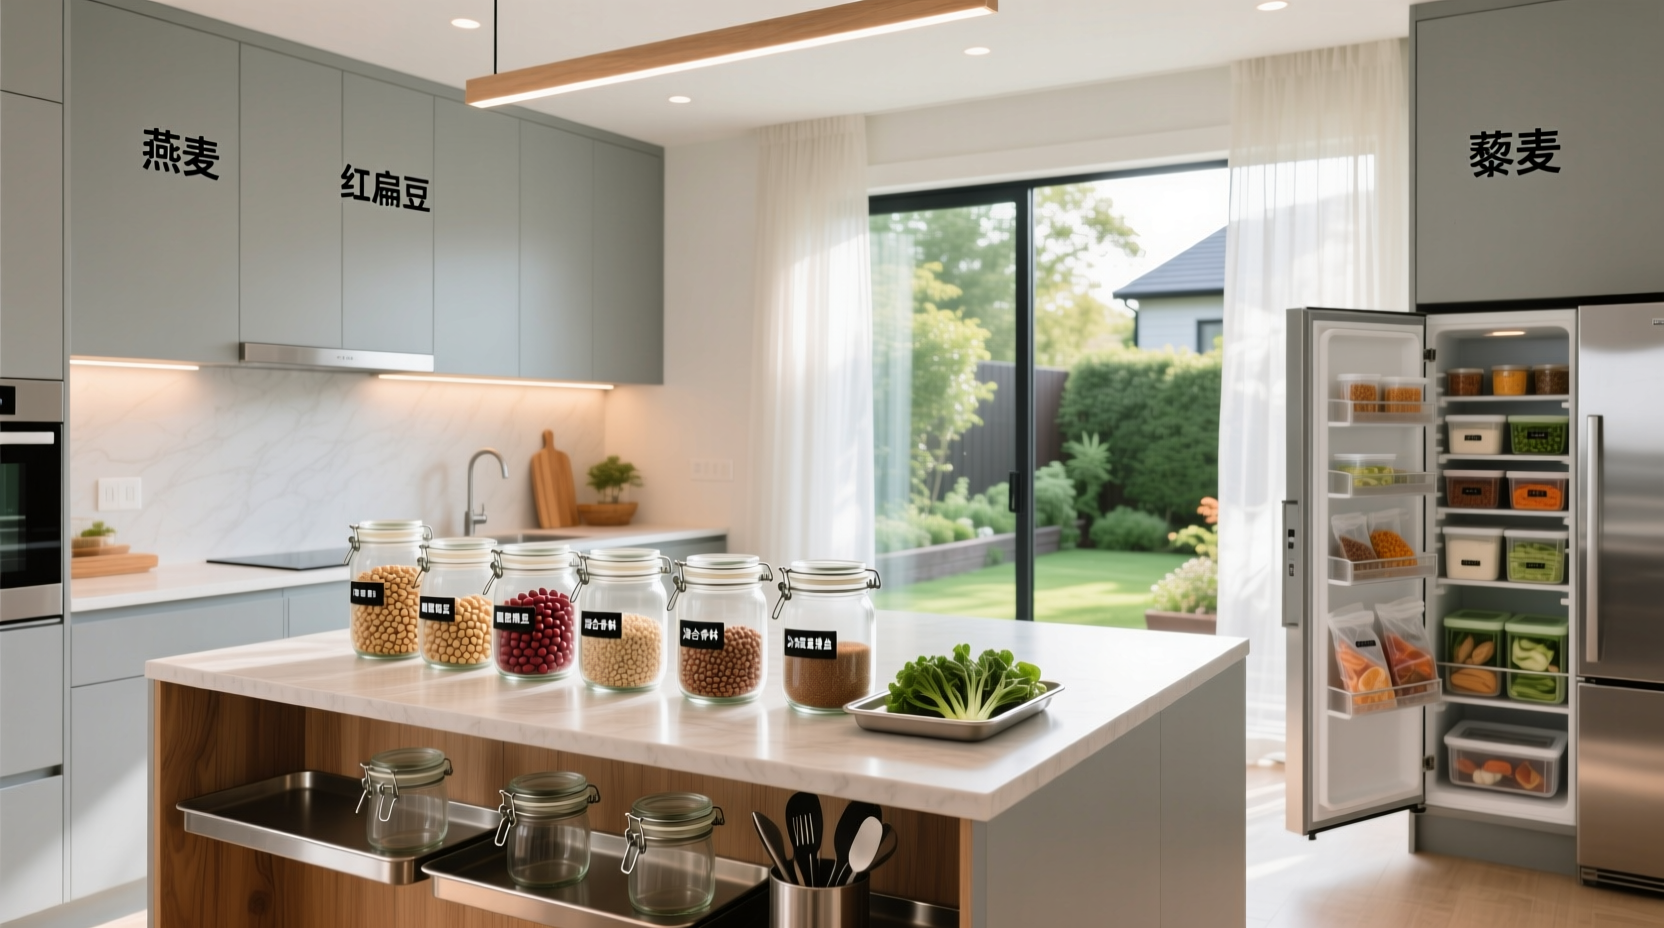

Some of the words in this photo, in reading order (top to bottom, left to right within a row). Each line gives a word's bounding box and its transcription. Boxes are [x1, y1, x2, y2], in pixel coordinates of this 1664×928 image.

[142, 127, 220, 181] 燕麦
[1469, 127, 1561, 178] 藜麦
[340, 163, 431, 213] 红扁豆
